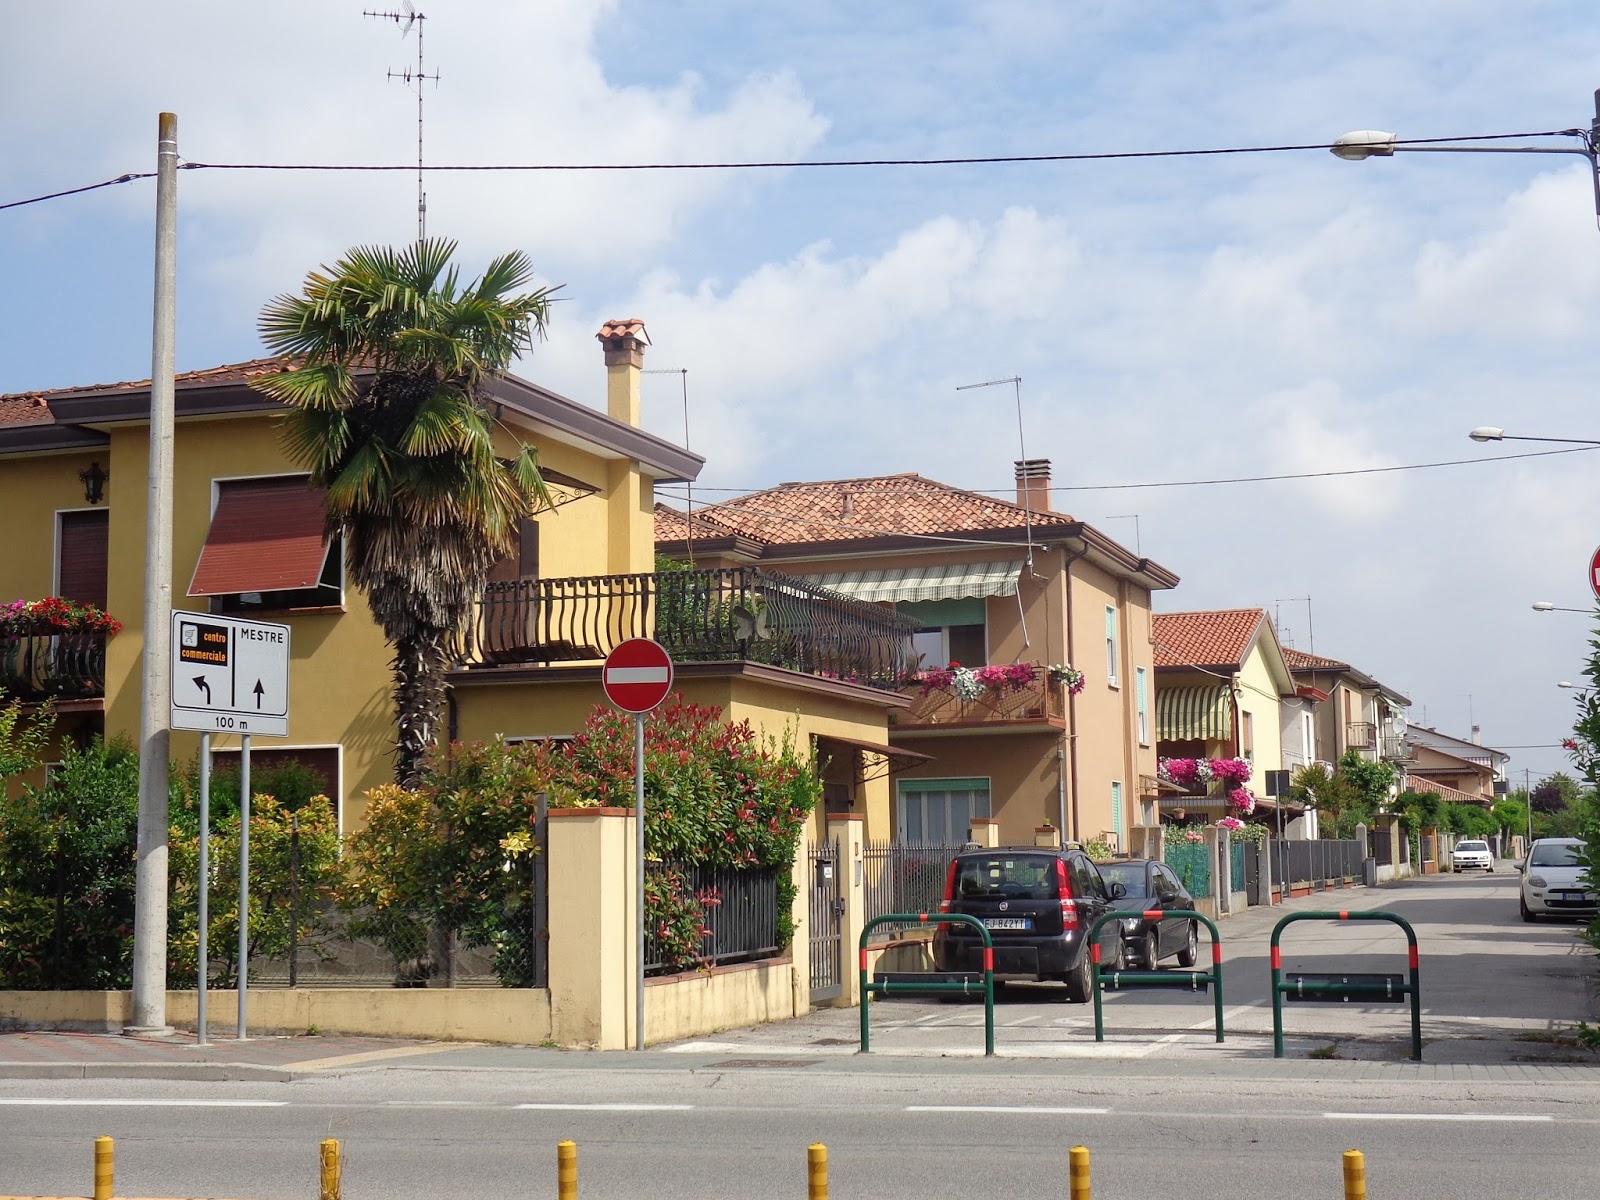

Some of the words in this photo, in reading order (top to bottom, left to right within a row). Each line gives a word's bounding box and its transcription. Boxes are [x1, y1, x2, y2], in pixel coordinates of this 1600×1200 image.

[204, 632, 226, 643] centro
[241, 628, 284, 644] MESTRE
[181, 649, 226, 662] commerciale
[215, 716, 234, 728] 100
[239, 720, 248, 730] m
